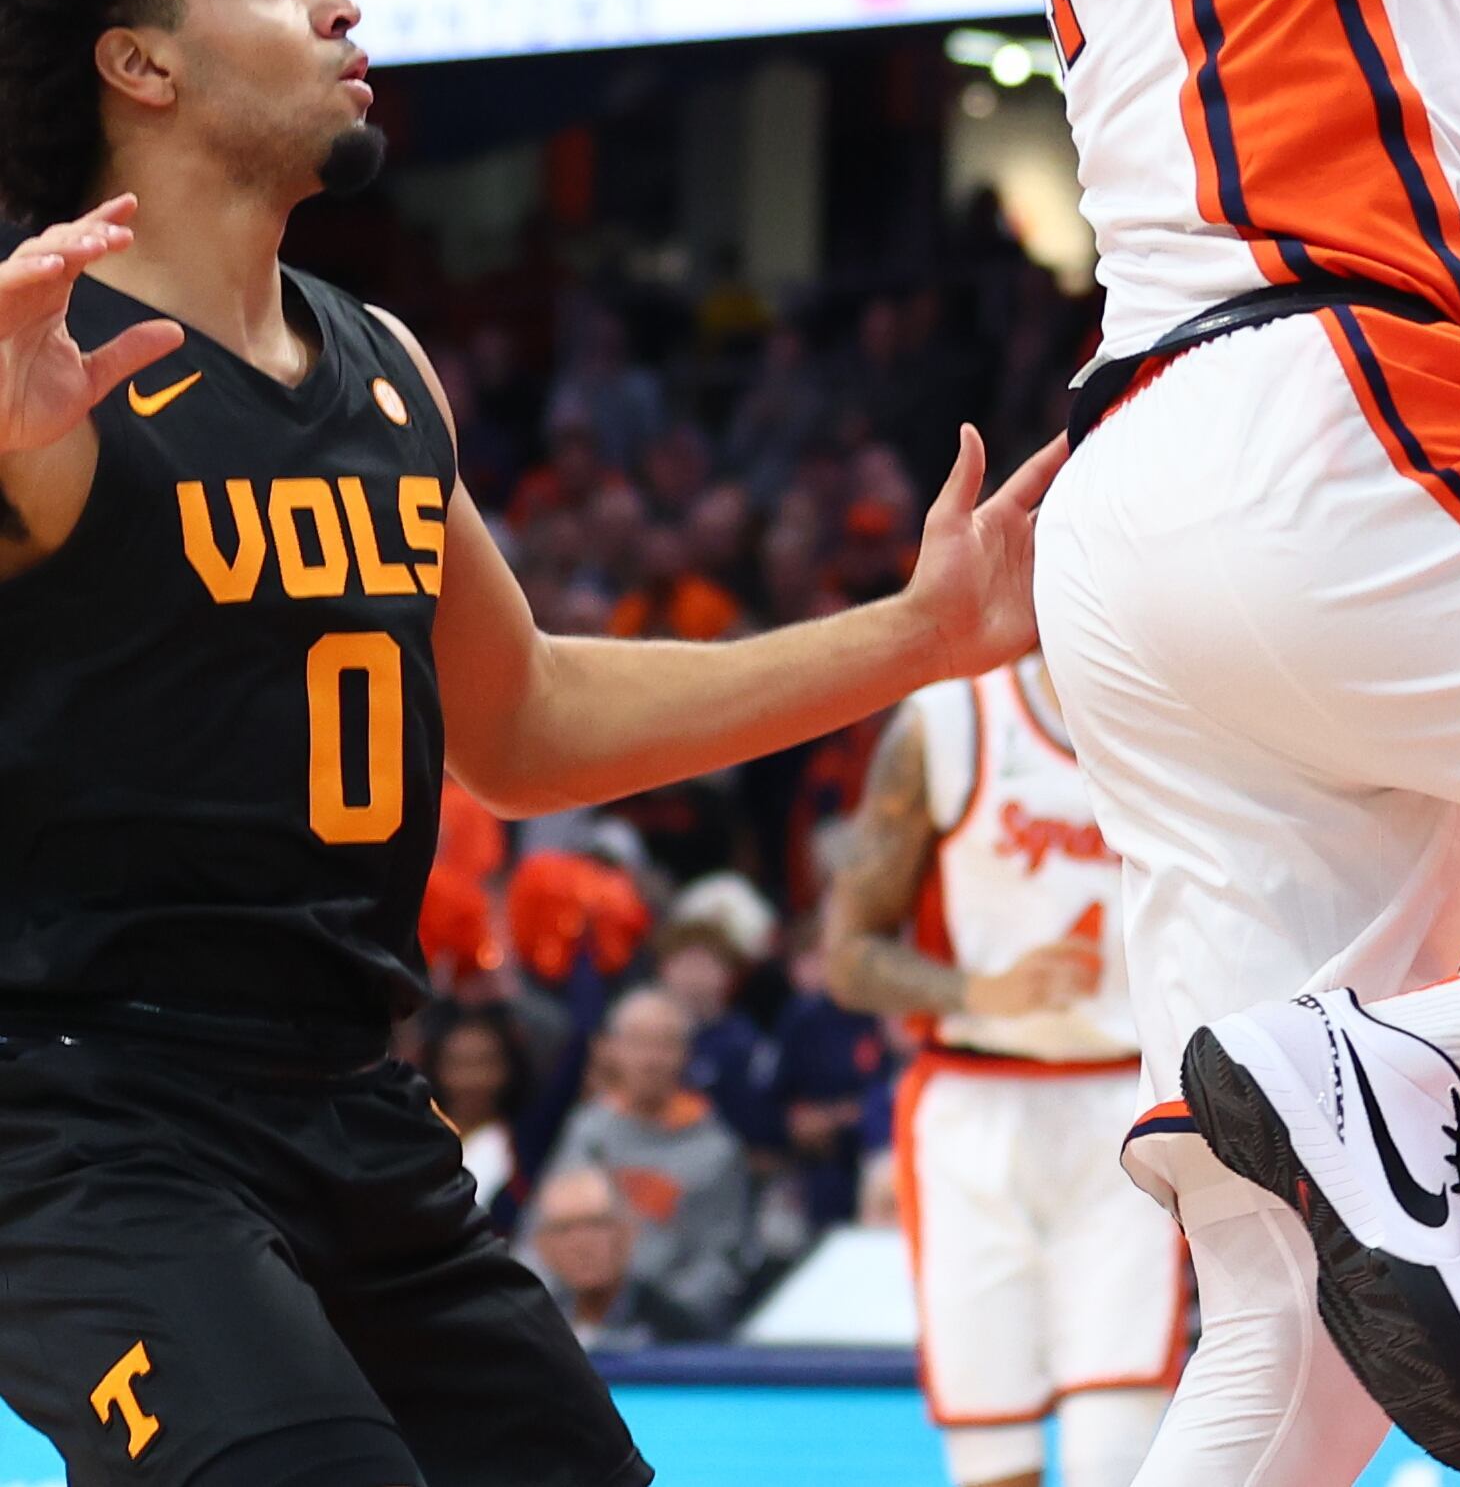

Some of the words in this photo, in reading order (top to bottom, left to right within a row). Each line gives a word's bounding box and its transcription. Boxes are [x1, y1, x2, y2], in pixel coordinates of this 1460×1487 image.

[176, 476, 445, 604] VOLS
[307, 631, 403, 845] 0
[90, 1339, 161, 1460] T
